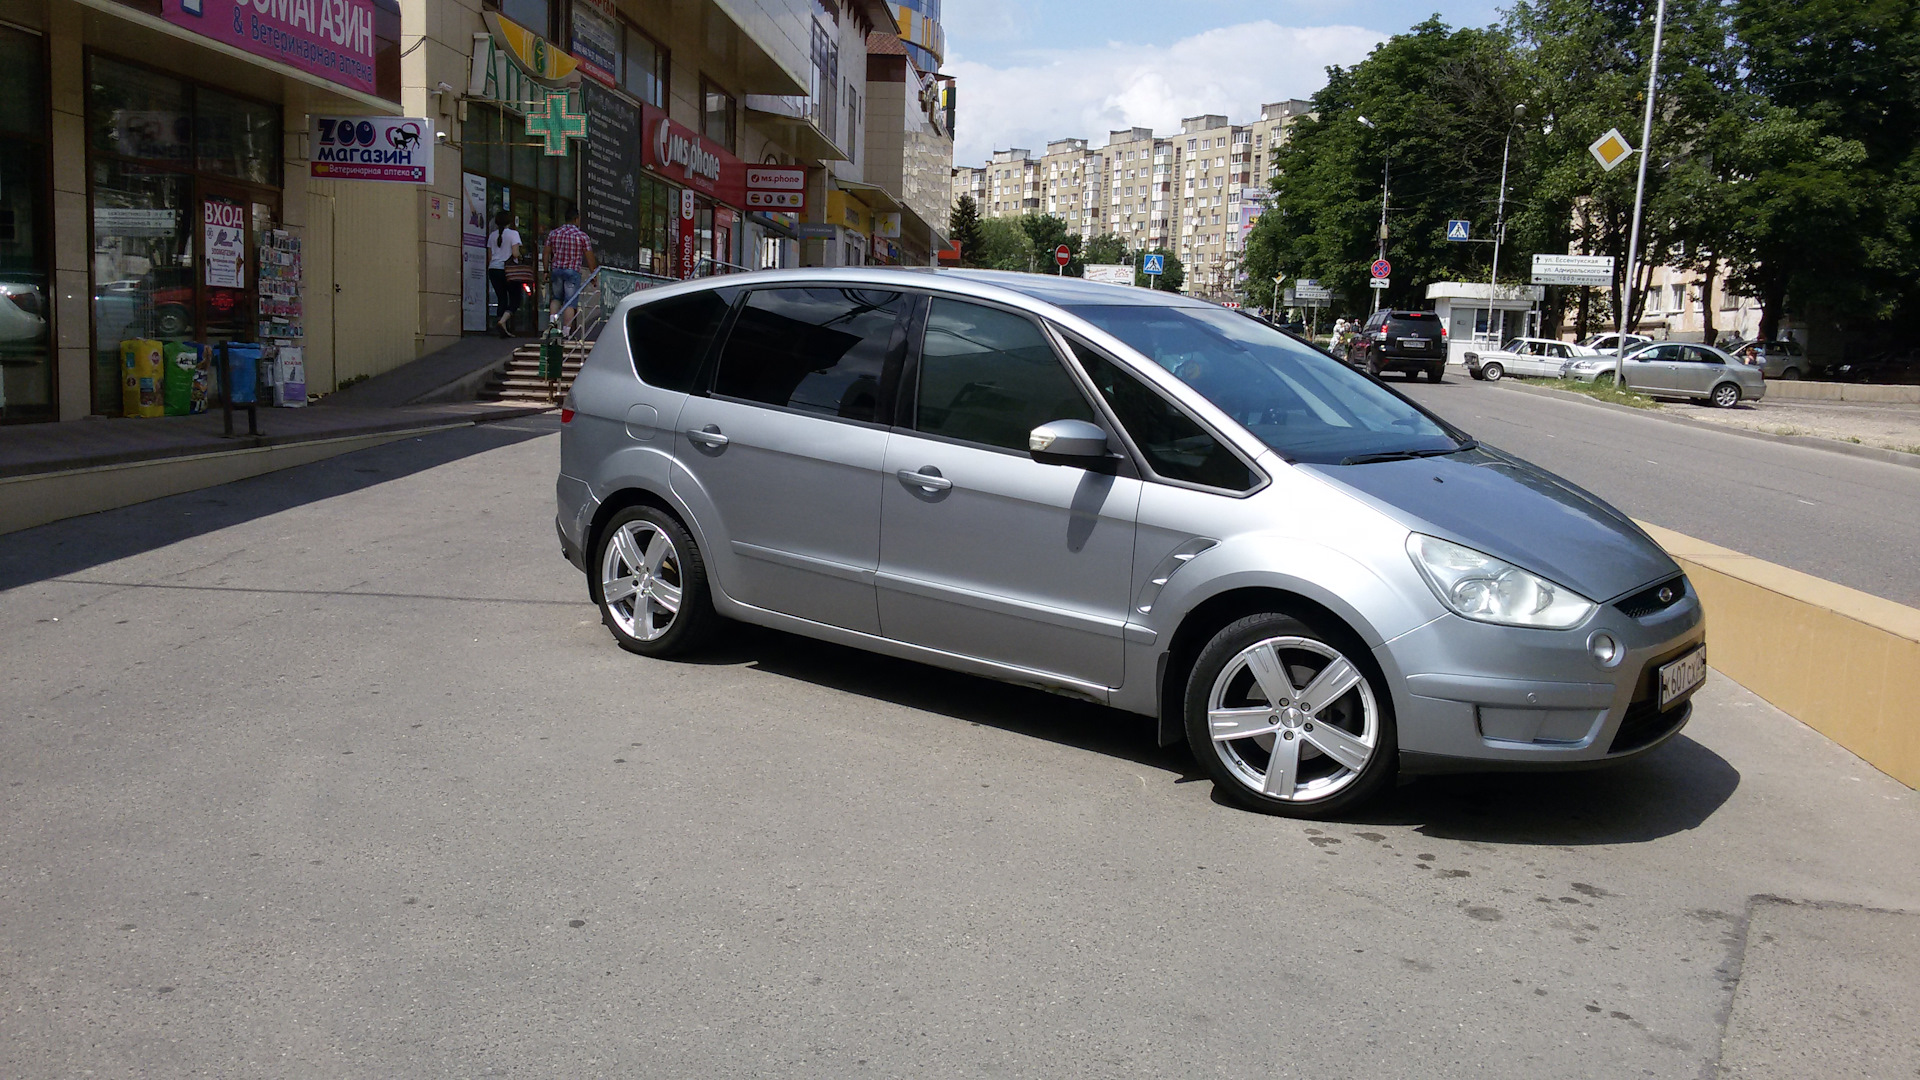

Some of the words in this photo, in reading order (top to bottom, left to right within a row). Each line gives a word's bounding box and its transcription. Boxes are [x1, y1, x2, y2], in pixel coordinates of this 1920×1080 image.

[232, 6, 245, 36] &
[251, 15, 336, 69] Ветеринарная
[339, 54, 373, 83] аптека
[470, 32, 587, 116] АПТА
[318, 147, 411, 164] магазин
[329, 164, 382, 177] Ветеринарная
[384, 168, 410, 176] аптека
[204, 202, 244, 228] ВХОД
[1555, 256, 1599, 265] Ессентукская
